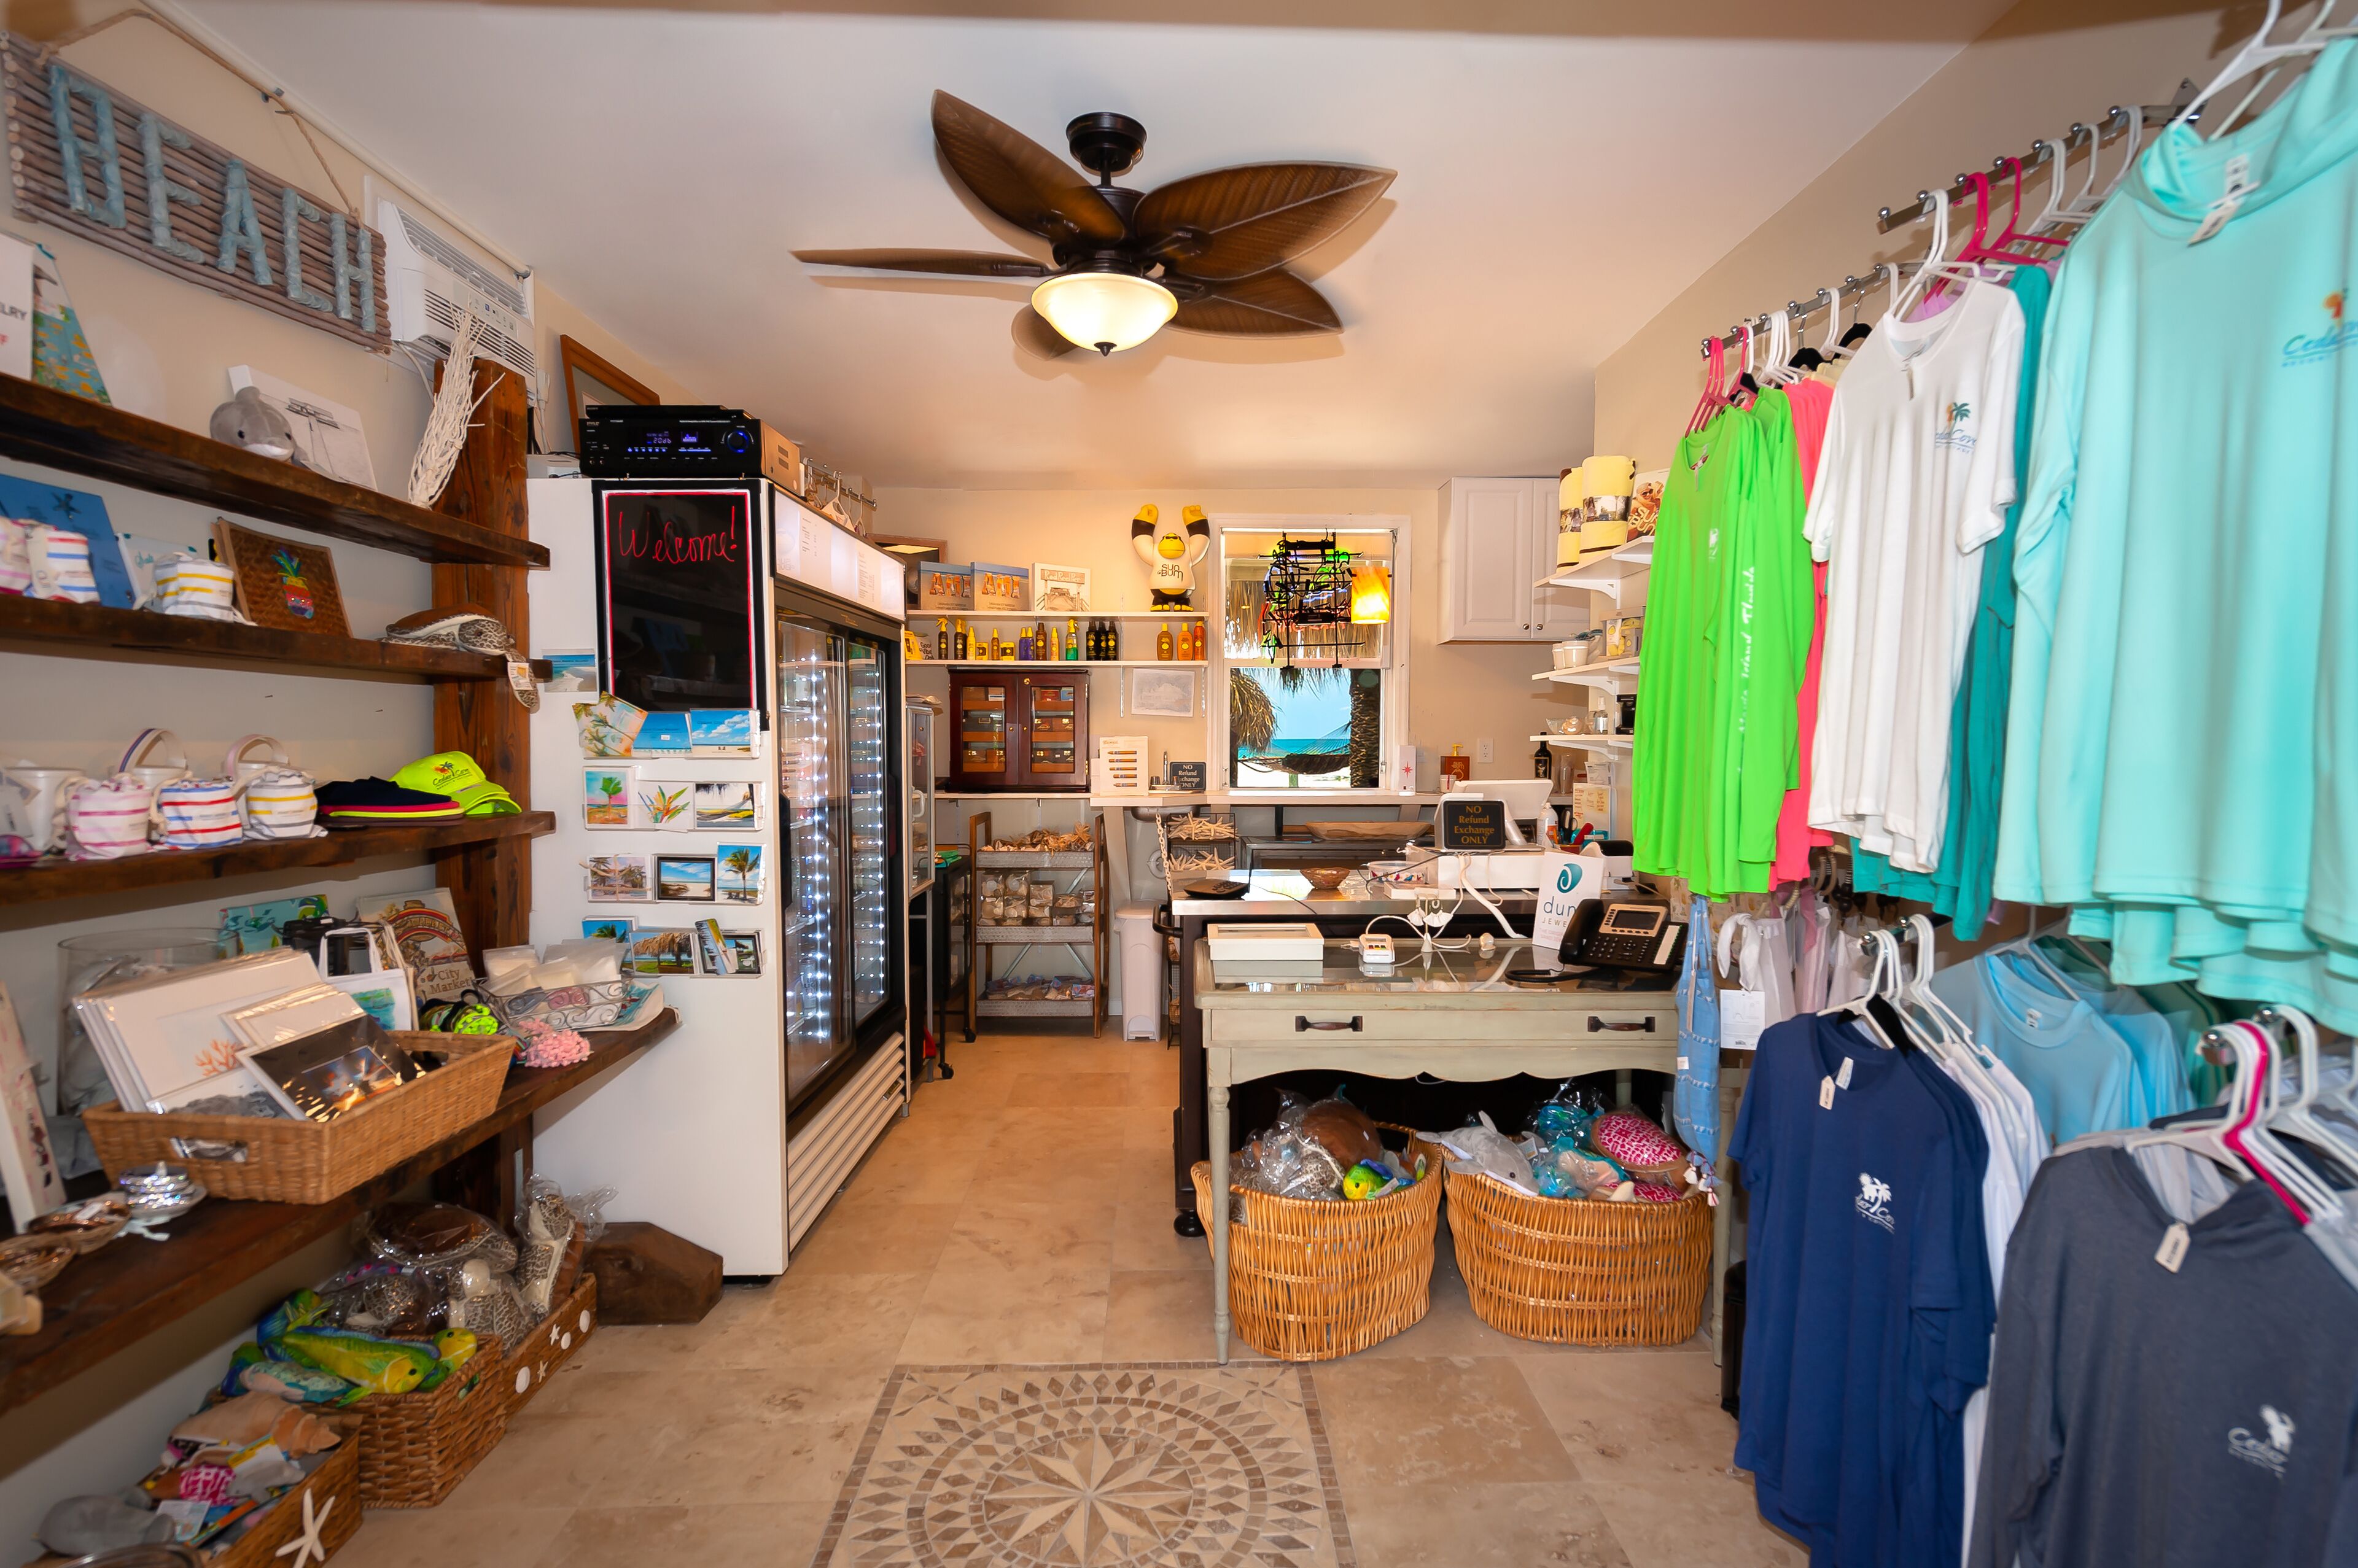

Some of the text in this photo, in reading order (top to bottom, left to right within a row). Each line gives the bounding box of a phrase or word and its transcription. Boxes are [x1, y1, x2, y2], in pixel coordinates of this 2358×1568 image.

[49, 64, 377, 333] BEACH
[618, 505, 737, 565] Welcome!
[1454, 825, 1495, 836] Exchange
[1461, 836, 1488, 844] ONLY
[1543, 896, 1577, 917] dun
[1542, 917, 1568, 928] JEWE
[438, 969, 460, 981] City
